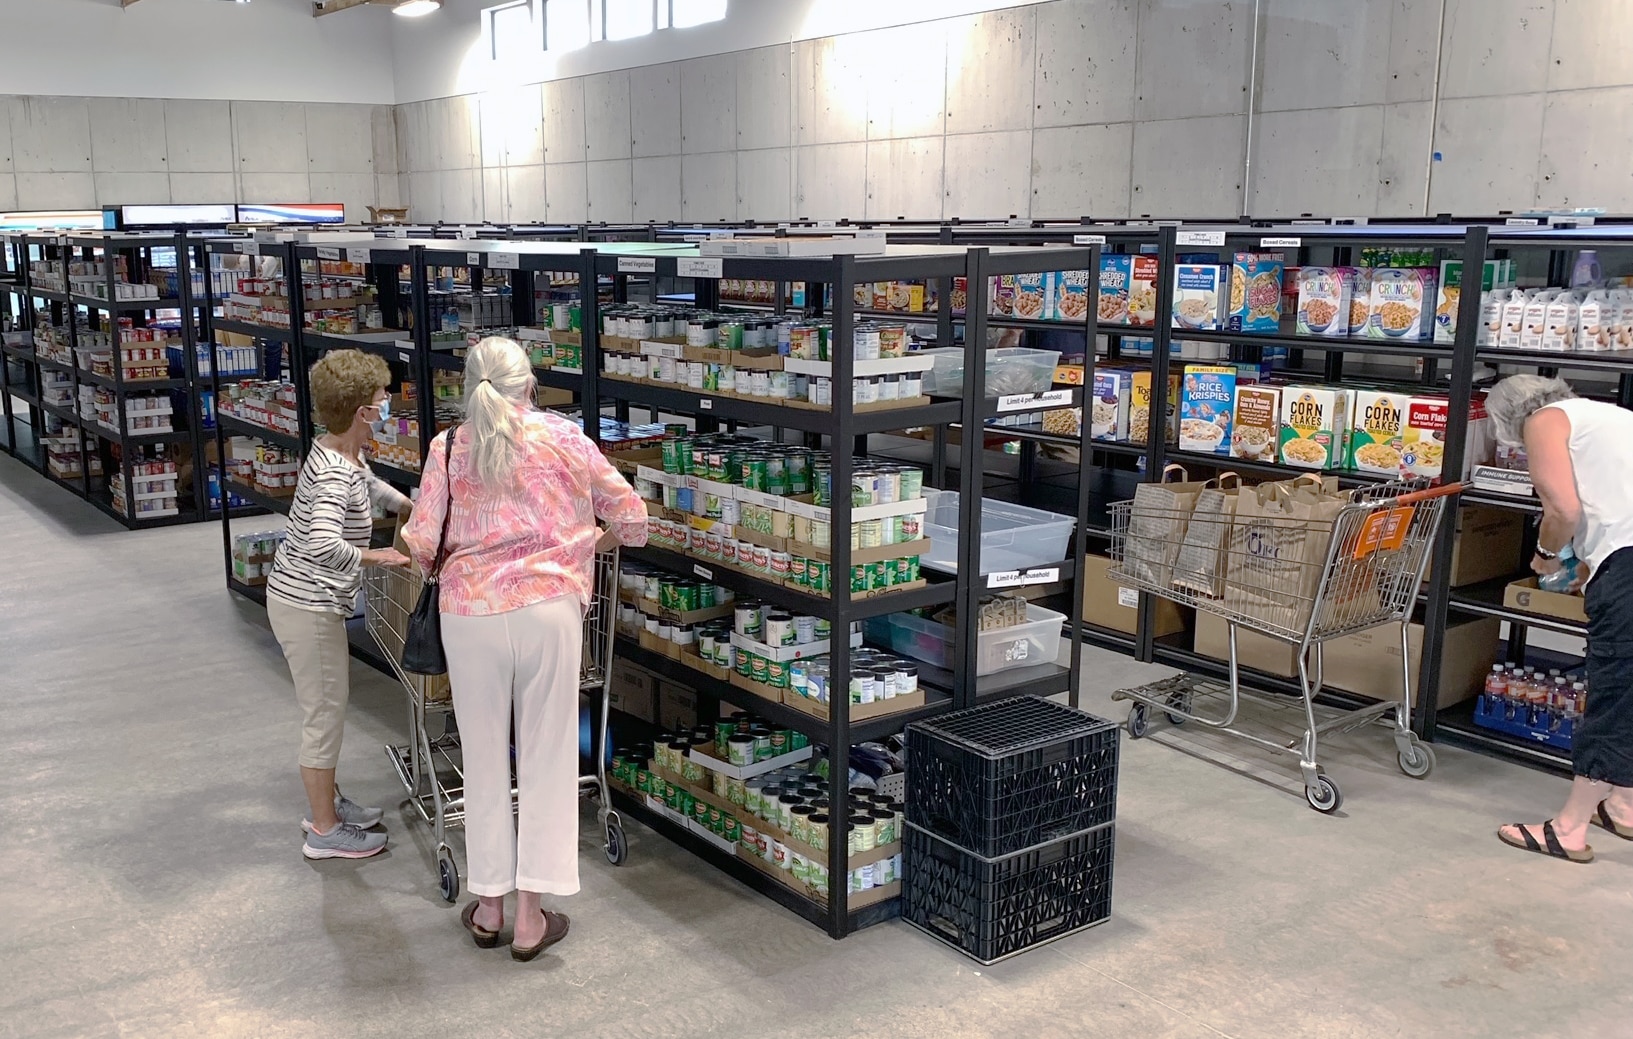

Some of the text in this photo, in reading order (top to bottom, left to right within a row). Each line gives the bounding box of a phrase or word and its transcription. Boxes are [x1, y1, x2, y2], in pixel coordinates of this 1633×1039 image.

[1001, 275, 1015, 287] BRA
[1305, 281, 1334, 292] CRUNCH
[1379, 283, 1414, 295] CRUNCH
[1198, 382, 1222, 392] RICE
[1188, 391, 1230, 402] KRISPIES
[1290, 401, 1323, 417] CORN
[1365, 405, 1401, 422] CORN
[1289, 415, 1322, 427] FLAKES
[1413, 411, 1447, 422] Corn Flak
[1364, 418, 1400, 432] FLAKES
[1481, 470, 1531, 482] IMMUNE SUPPO
[996, 574, 1009, 582] Limit
[1516, 591, 1530, 606] G
